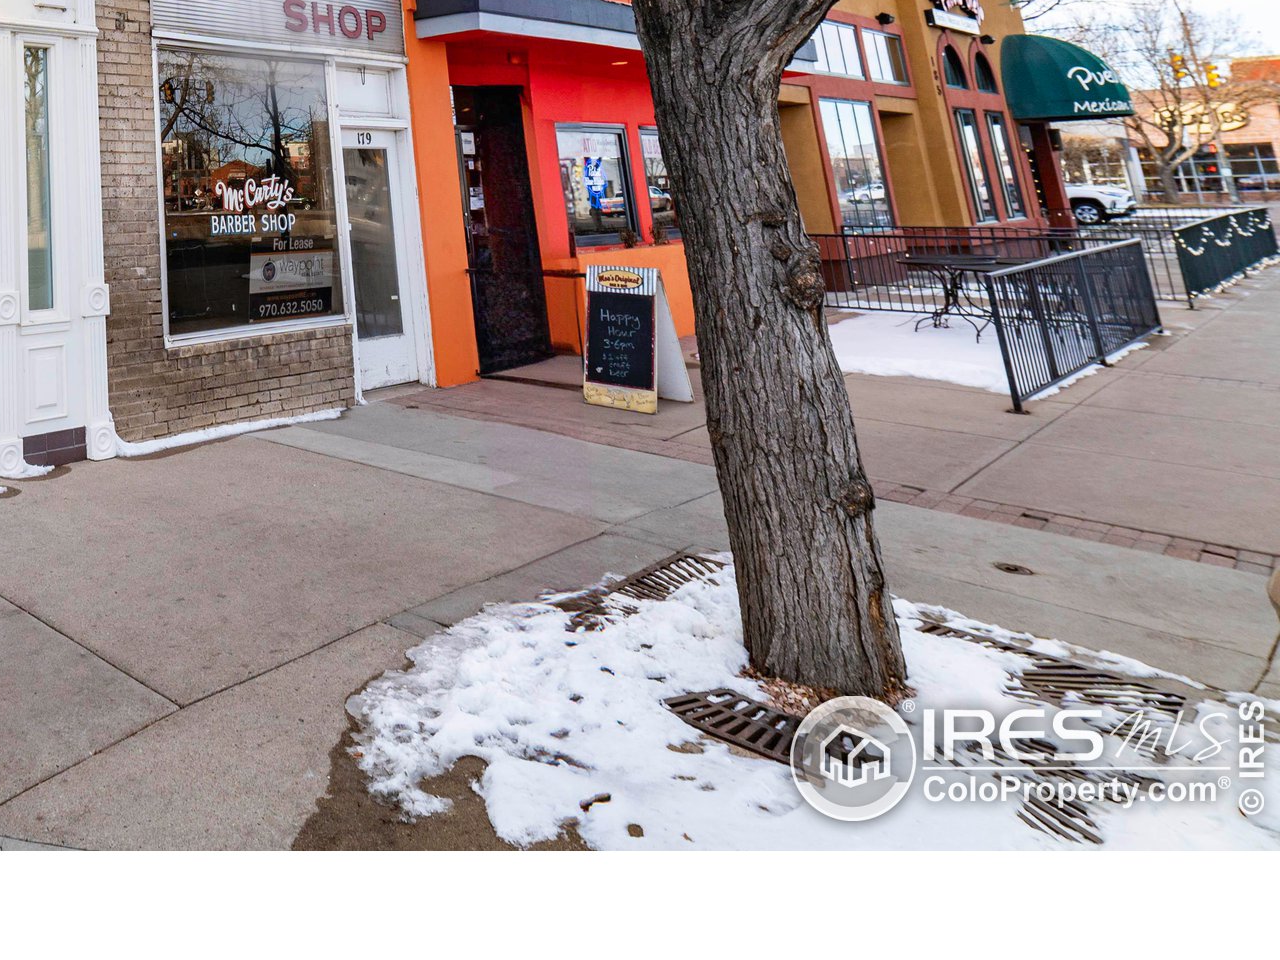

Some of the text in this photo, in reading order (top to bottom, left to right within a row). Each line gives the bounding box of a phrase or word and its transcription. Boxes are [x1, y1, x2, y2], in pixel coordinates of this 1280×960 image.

[356, 132, 372, 145] 179
[211, 212, 296, 234] BARBER SHOP
[272, 236, 314, 251] For Lease
[280, 255, 324, 275] waypoint
[259, 299, 323, 317] 970.632.5050
[600, 308, 641, 330] Happy
[607, 326, 636, 337] Hour
